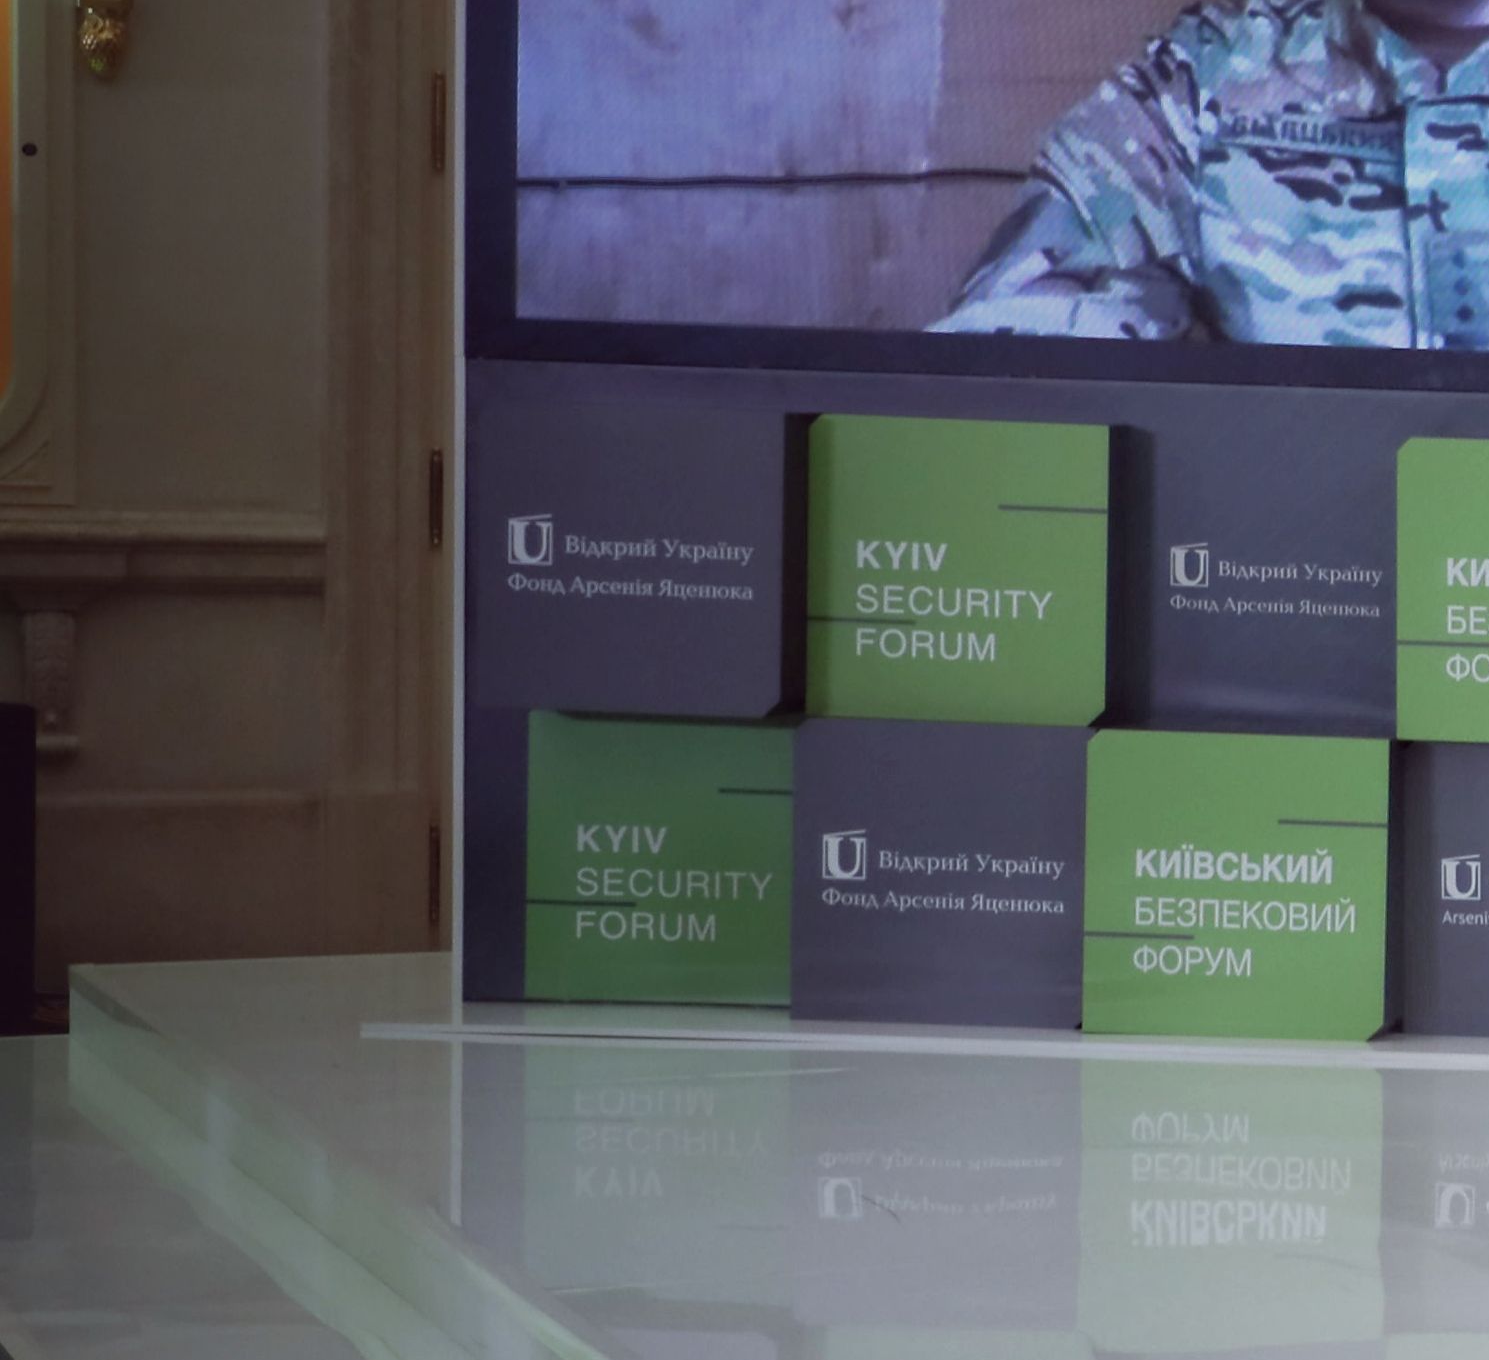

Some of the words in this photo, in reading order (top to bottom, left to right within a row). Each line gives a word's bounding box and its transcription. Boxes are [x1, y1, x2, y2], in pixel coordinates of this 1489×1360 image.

[565, 535, 657, 560] Відкрий
[663, 539, 754, 566] Україну
[856, 539, 947, 572] KYIV
[508, 573, 566, 595] Фонд
[570, 576, 653, 598] Арсенія
[658, 579, 753, 601] Яценюка
[1218, 560, 1297, 582] Відкрий
[1304, 564, 1383, 587] Україну
[856, 585, 1053, 620] SECURITY
[1170, 594, 1219, 612] Фонд
[856, 628, 997, 662] FORUM
[576, 824, 667, 854] KYIV
[879, 850, 968, 875] Відкрий
[975, 854, 1065, 880] Україну
[1135, 844, 1333, 885] КИЇВСЬКИЙ
[576, 868, 773, 900] SECURITY
[822, 887, 879, 909] Фонд
[883, 891, 965, 912] Арсенія
[971, 894, 1064, 914] Яценюка
[1134, 895, 1357, 934] БЕЗПЕКОВИЙ
[575, 911, 716, 942] FORUM
[1133, 944, 1252, 977] ФОРУМ
